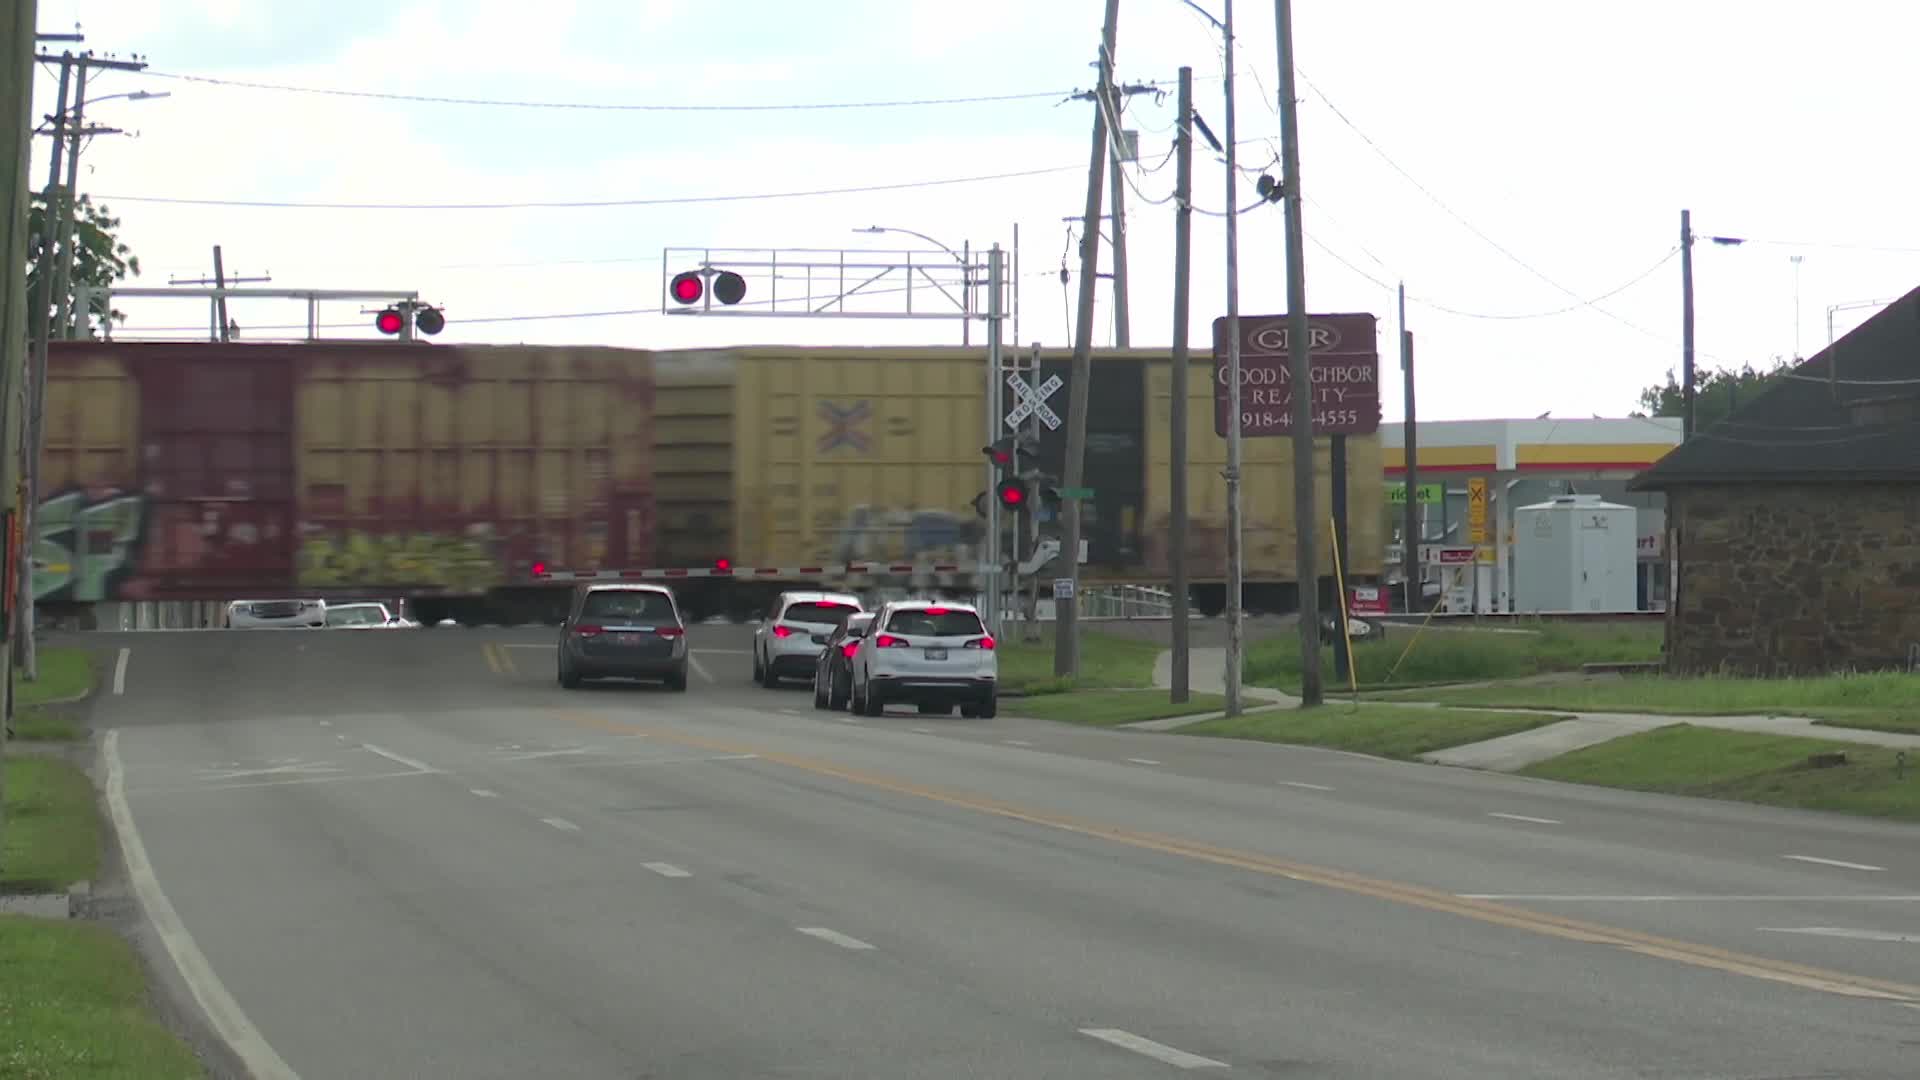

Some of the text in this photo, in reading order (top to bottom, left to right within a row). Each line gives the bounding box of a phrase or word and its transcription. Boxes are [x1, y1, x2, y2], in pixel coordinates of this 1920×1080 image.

[1257, 328, 1330, 349] GR
[1279, 364, 1373, 385] NGHBOR
[1253, 387, 1348, 405] RETY
[1242, 409, 1358, 427] 918-4-4555
